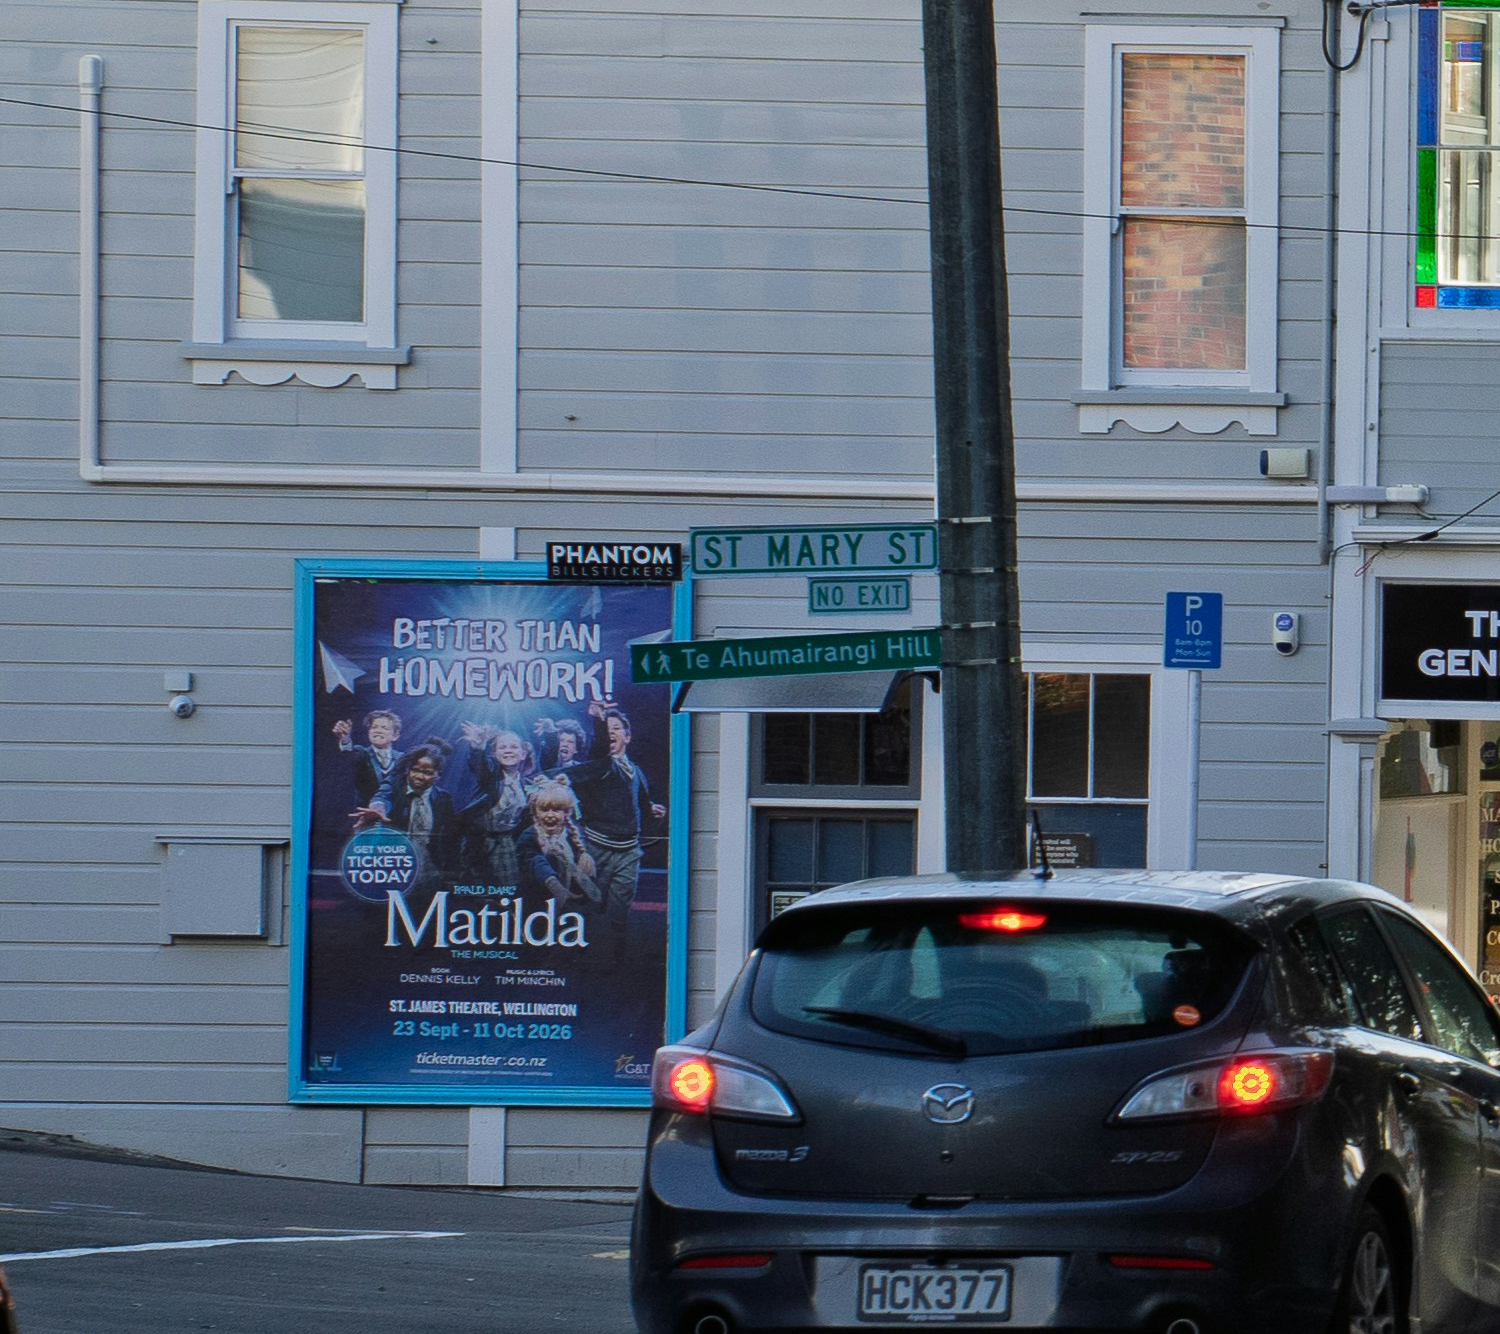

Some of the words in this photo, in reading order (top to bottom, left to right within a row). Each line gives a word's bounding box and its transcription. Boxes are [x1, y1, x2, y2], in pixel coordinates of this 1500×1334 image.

[551, 545, 673, 565] PHANTOM
[704, 535, 743, 568] ST
[767, 533, 864, 567] MARY
[888, 532, 926, 564] ST
[552, 565, 674, 578] BILLSTICKERS
[816, 585, 843, 606] NO
[857, 584, 904, 606] EXIT
[1185, 595, 1203, 617] P
[393, 618, 505, 652] BETTER
[517, 619, 601, 653] THAN
[1185, 619, 1203, 636] 10
[681, 648, 711, 669] Te
[720, 638, 878, 666] Ahumairangi
[887, 635, 932, 659] Hill
[379, 656, 615, 703] HOMEWORK!
[353, 845, 376, 854] GET
[377, 845, 407, 854] YOUR
[347, 856, 414, 868] TICKETS
[348, 870, 412, 884] TODAY
[383, 889, 590, 948] Matilda
[451, 949, 471, 959] THE
[473, 950, 519, 960] MUSICAL
[400, 973, 443, 983] DENNIS
[446, 975, 481, 985] KELLY
[495, 975, 515, 985] TIM
[517, 976, 566, 986] MINCHIN
[389, 1000, 407, 1012] ST.
[408, 1000, 447, 1014] JAMES
[448, 1001, 502, 1016] THEATRE,
[503, 1002, 577, 1016] WELLINGTON
[393, 1020, 415, 1036] 23
[419, 1021, 460, 1040] Sept
[473, 1023, 490, 1038] 11
[494, 1022, 525, 1038] Oct
[528, 1023, 573, 1040] 2026
[625, 1063, 651, 1074] G&T
[735, 1149, 788, 1161] mazda
[789, 1145, 810, 1162] 3
[1110, 1150, 1184, 1165] SP25
[865, 1274, 1004, 1310] HCK377
